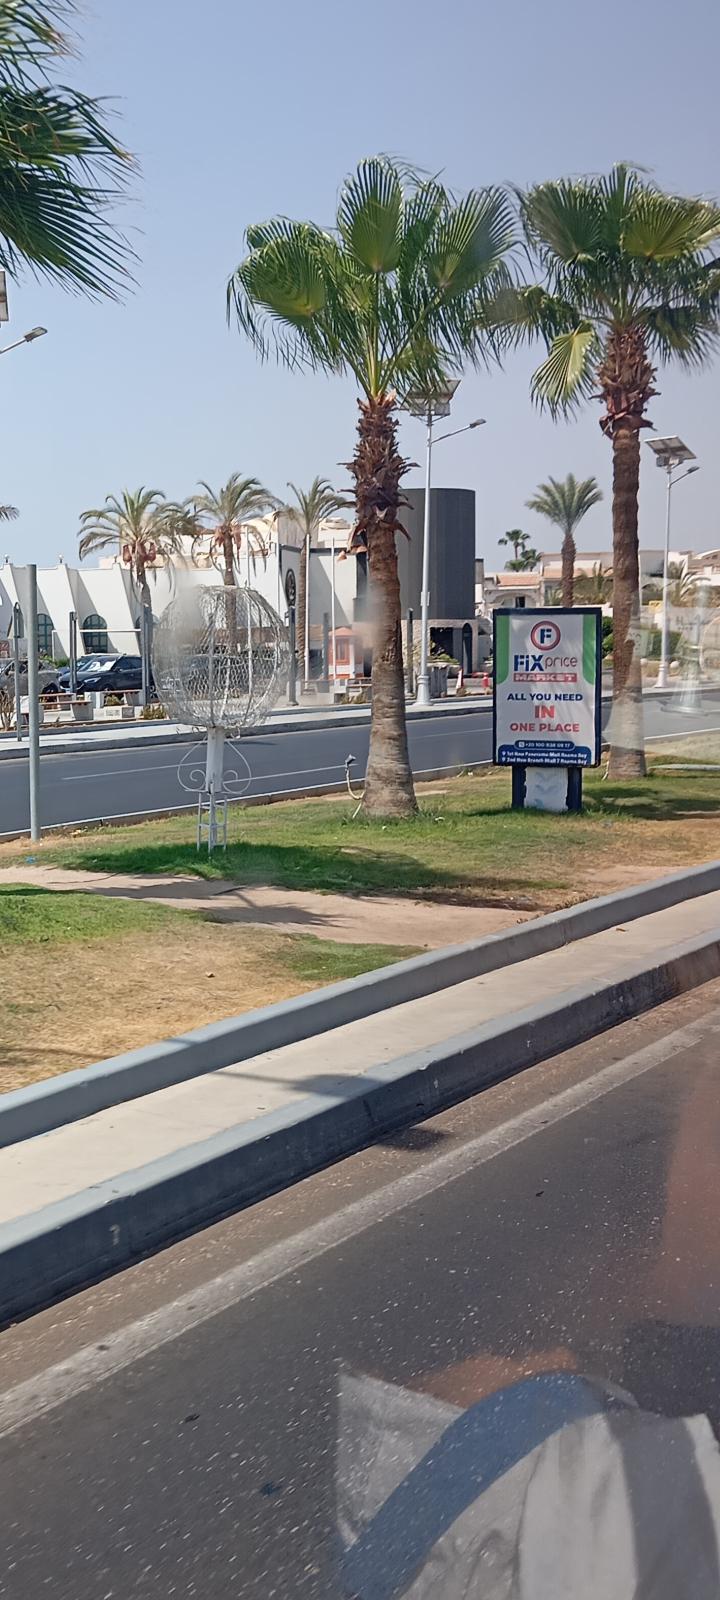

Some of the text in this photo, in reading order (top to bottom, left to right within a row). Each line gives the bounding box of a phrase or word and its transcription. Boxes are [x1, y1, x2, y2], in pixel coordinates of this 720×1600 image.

[544, 656, 578, 669] price
[507, 693, 583, 701] ALL YOU NEED
[535, 705, 555, 718] IN
[510, 723, 580, 732] ONE PLACE
